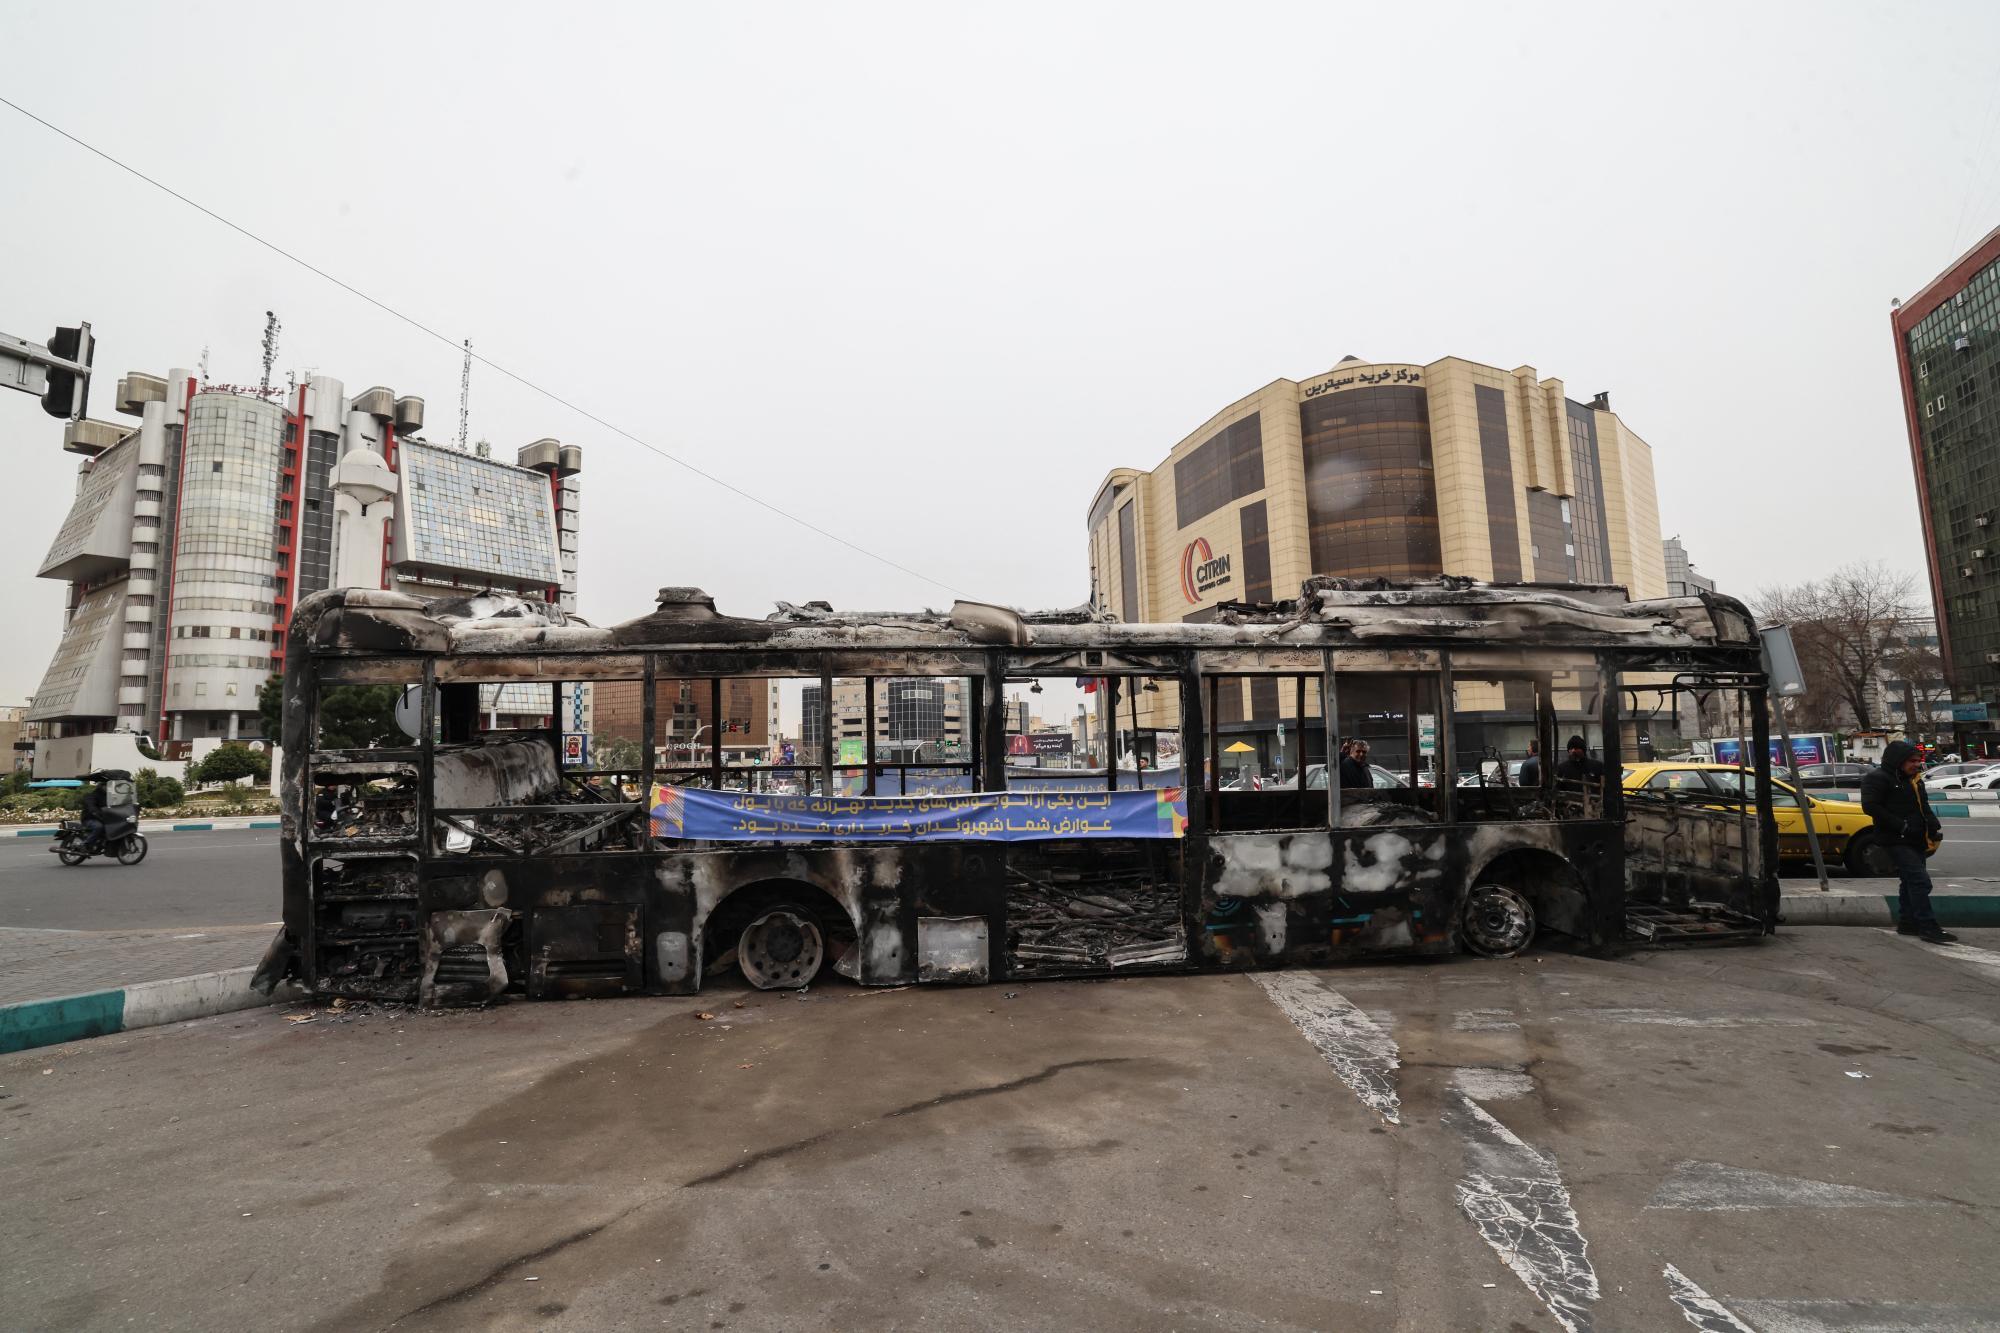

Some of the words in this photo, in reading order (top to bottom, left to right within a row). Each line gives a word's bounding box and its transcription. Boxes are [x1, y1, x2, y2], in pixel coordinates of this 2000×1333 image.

[1359, 369, 1391, 384] خرید
[1393, 368, 1420, 383] مرکز
[1304, 376, 1354, 397] سیترین
[1196, 553, 1231, 583] CITRIN
[734, 795, 771, 815] پول
[774, 798, 784, 815] با
[787, 799, 808, 812] که
[869, 799, 914, 815] جدید
[1047, 793, 1074, 810] یکی
[1077, 793, 1112, 810] این
[733, 819, 779, 836] بود.
[781, 820, 830, 833] شده
[834, 819, 913, 837] خریداری
[916, 817, 1004, 836] شهروندان
[1006, 817, 1051, 831] شما
[1053, 816, 1112, 835] عوارض
